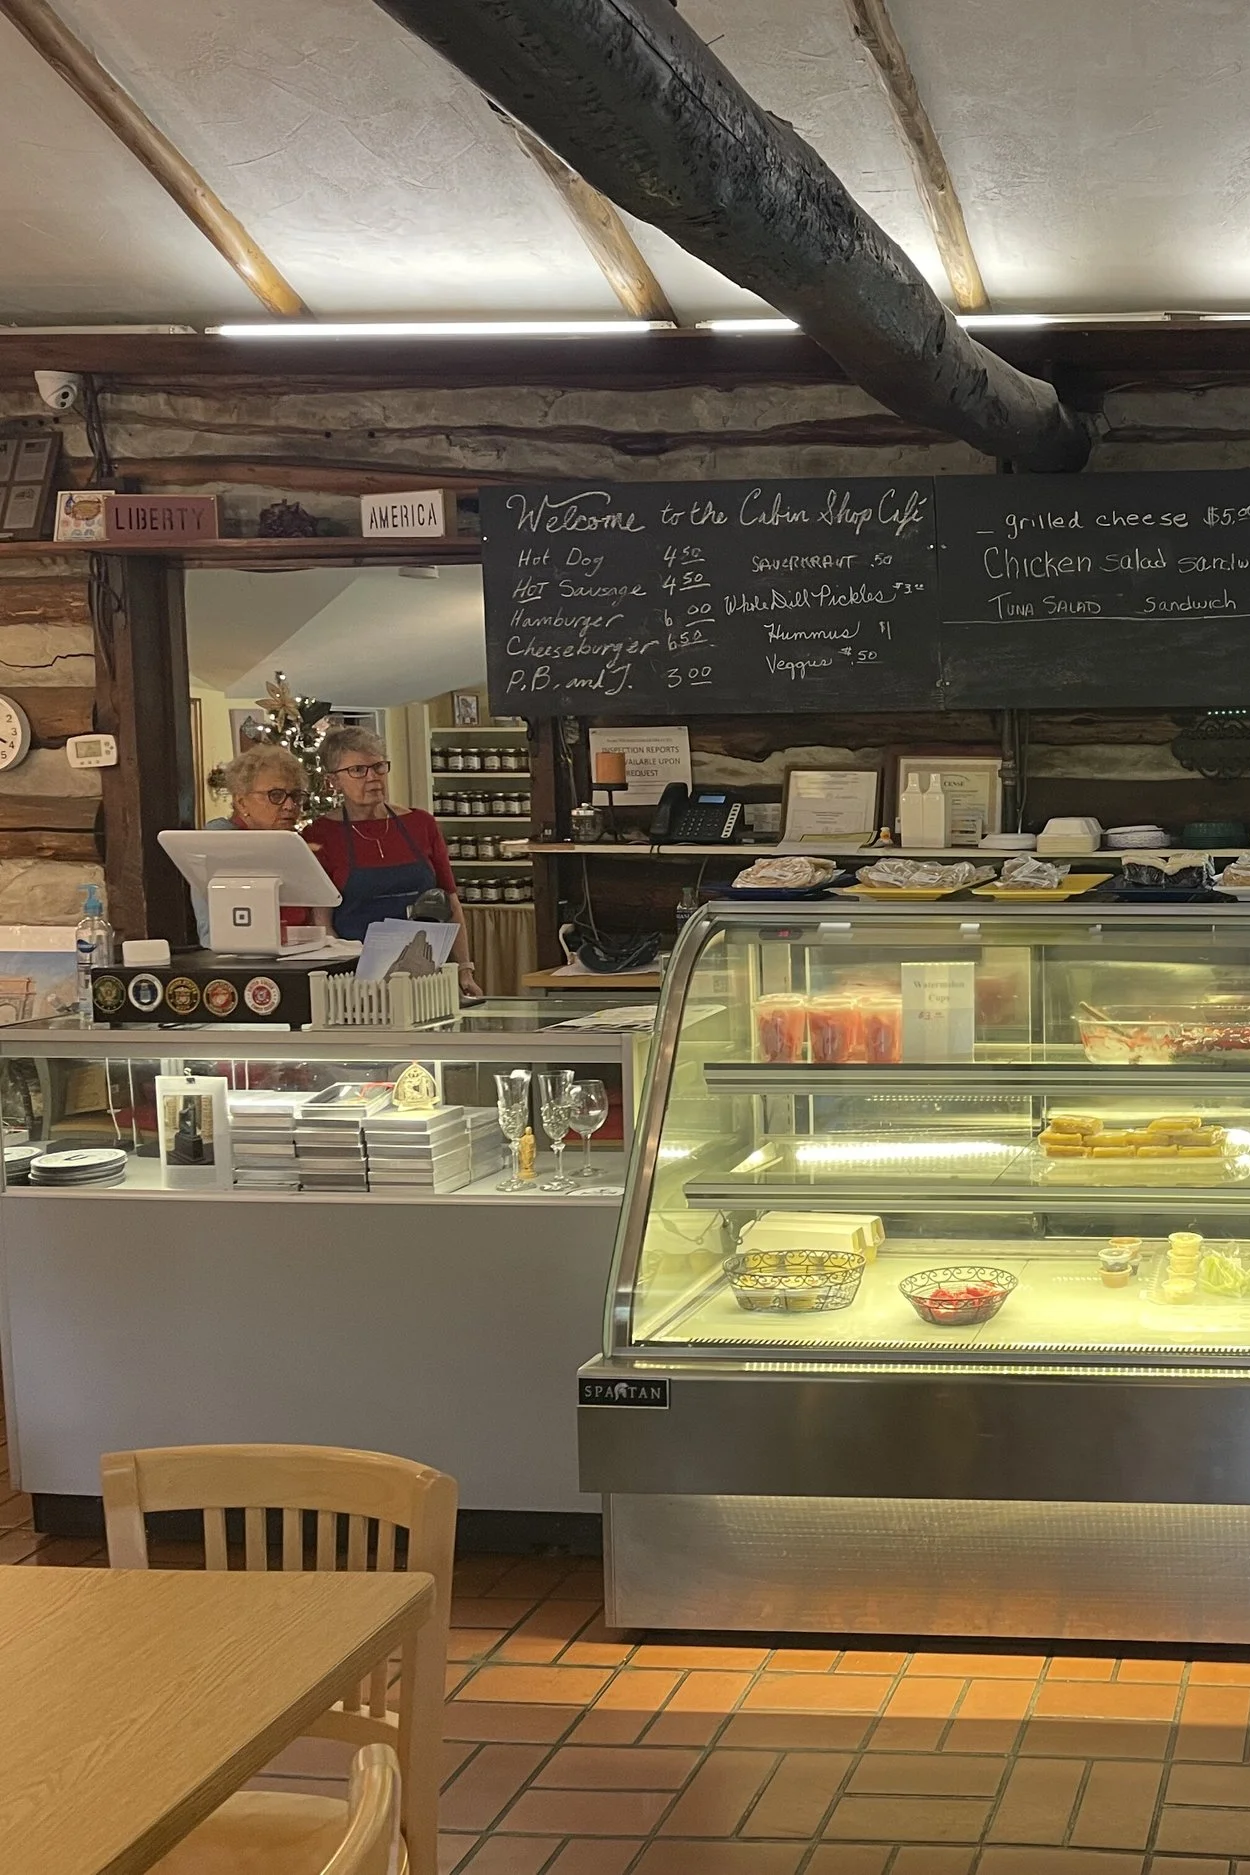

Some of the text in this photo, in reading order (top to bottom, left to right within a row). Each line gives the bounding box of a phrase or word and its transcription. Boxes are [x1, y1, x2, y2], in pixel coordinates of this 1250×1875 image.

[114, 506, 205, 532] LIBERTY
[368, 502, 438, 530] AMERICA
[506, 491, 646, 533] Welcome
[660, 502, 686, 526] to
[690, 501, 728, 526] the
[740, 488, 810, 526] Cabin
[817, 489, 873, 535] Shop
[1006, 511, 1084, 539] grilled
[1096, 511, 1189, 528] cheese
[518, 548, 550, 568] Hot
[566, 547, 604, 577] Dog
[984, 546, 1092, 579] Chicken
[559, 579, 647, 606] Sausage
[724, 593, 769, 616] Whole
[770, 588, 811, 610] Dill
[811, 583, 897, 607] Pickles
[510, 606, 624, 638] Hamburger
[764, 620, 861, 643] Hummus
[506, 635, 660, 669] Cheeseburger
[565, 669, 605, 690] and
[766, 653, 833, 680] Veggies
[6, 714, 13, 723] 2
[11, 728, 18, 736] 3
[1, 751, 8, 759] 5
[9, 741, 15, 749] 4
[646, 745, 680, 753] REPORTS
[658, 757, 681, 765] UPON
